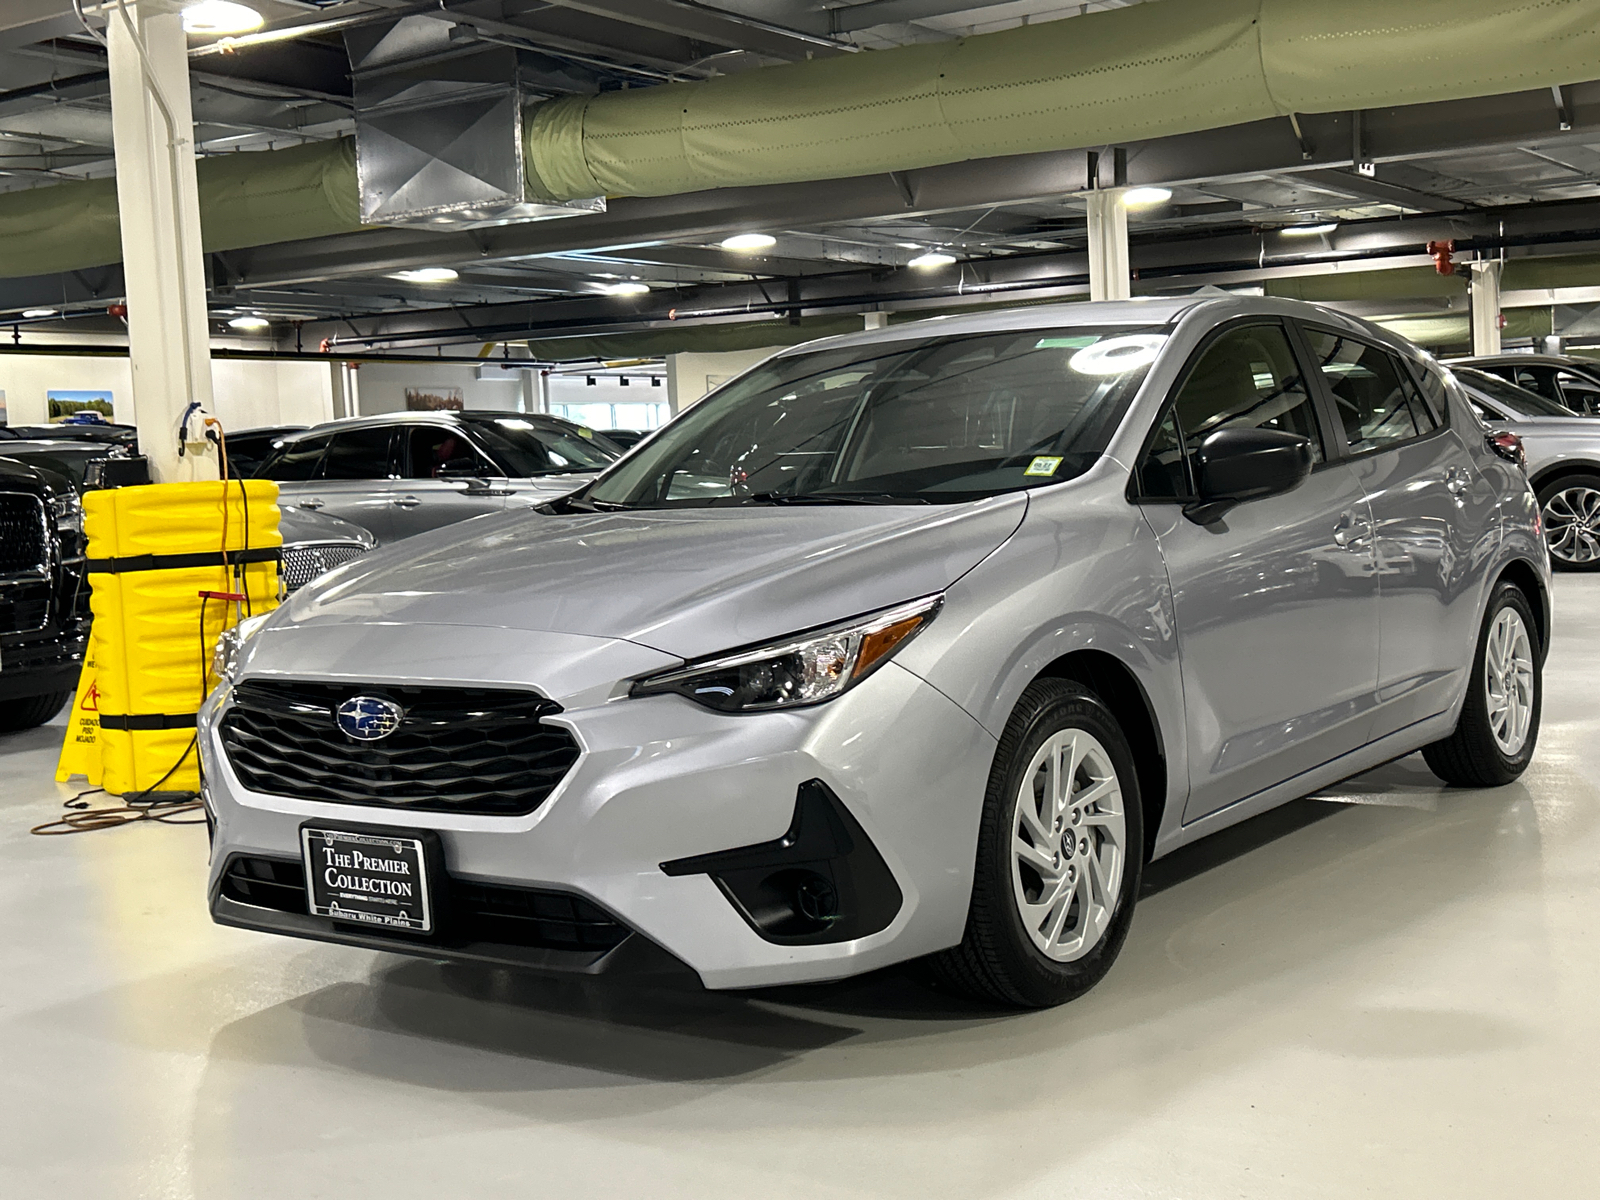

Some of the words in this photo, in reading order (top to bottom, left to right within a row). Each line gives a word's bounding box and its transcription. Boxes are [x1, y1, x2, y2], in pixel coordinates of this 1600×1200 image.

[76, 735, 96, 743] MOJADO
[82, 726, 94, 735] PISO
[323, 847, 352, 868] THE
[352, 850, 411, 875] PREMIER
[324, 867, 412, 897] COLLECTION
[329, 908, 356, 920] Subaru
[358, 913, 383, 924] White
[384, 917, 411, 928] Plains
